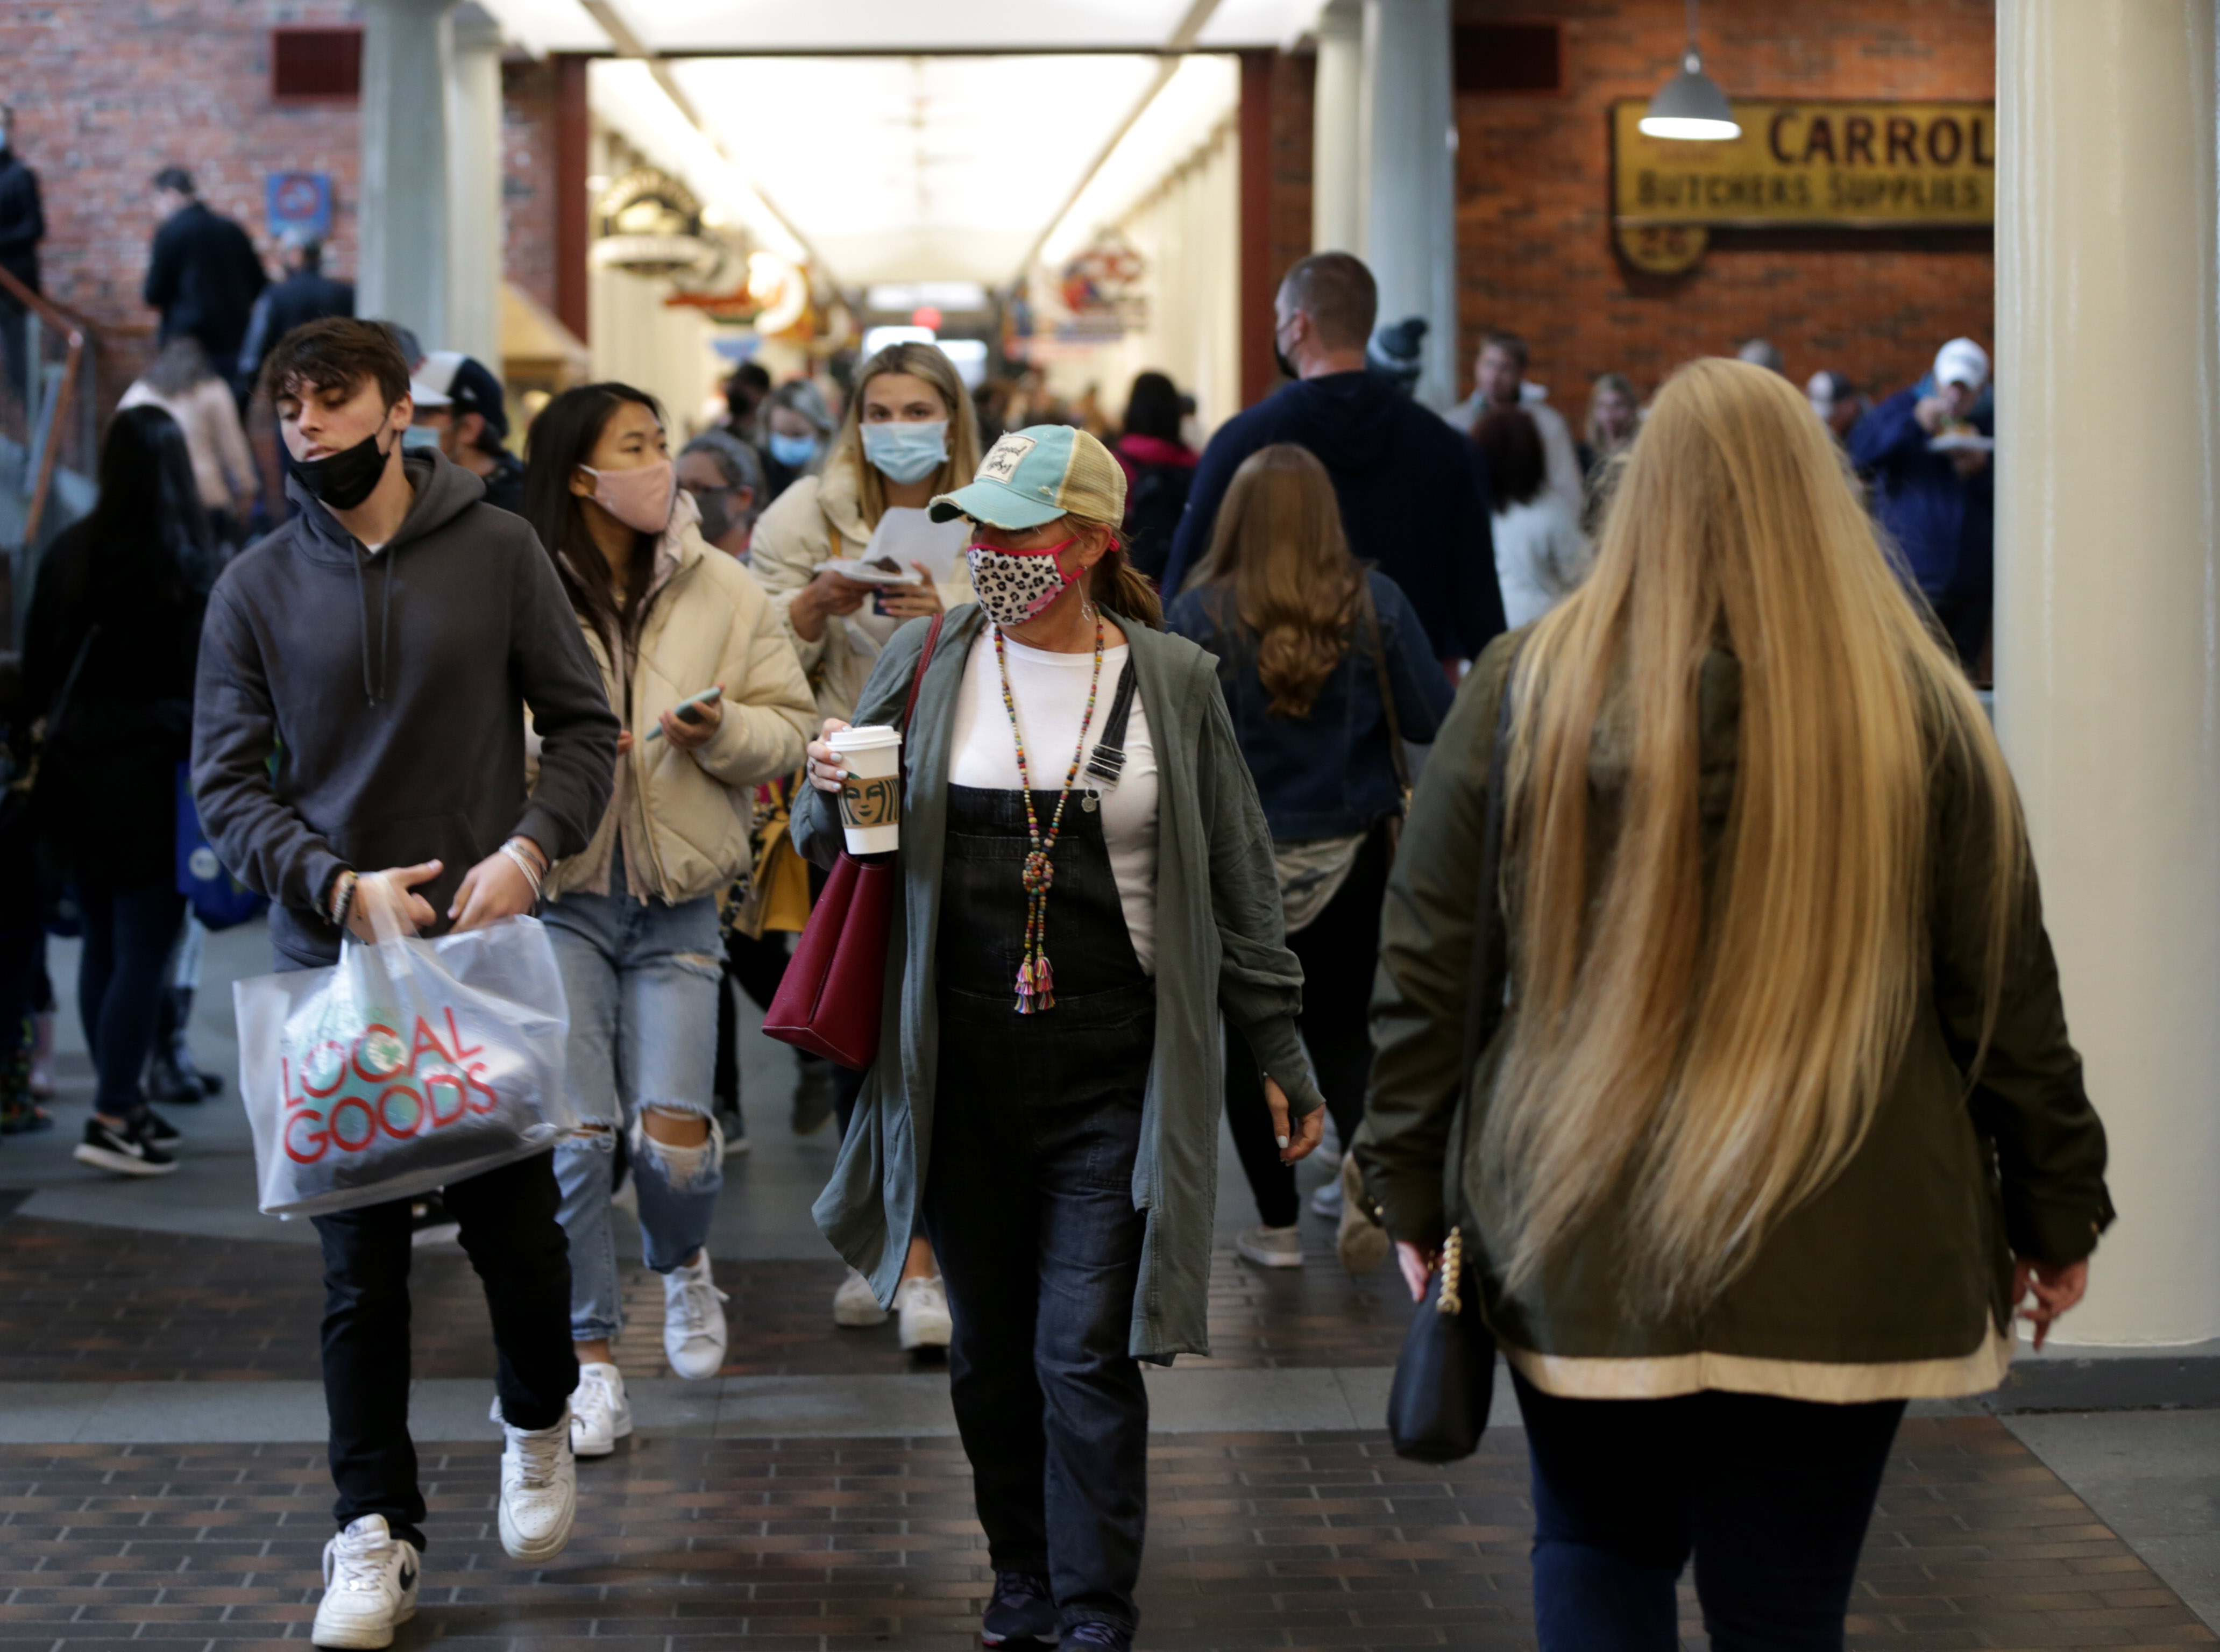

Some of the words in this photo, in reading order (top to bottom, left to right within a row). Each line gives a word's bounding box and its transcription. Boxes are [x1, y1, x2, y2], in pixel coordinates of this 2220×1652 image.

[1767, 111, 1995, 168] CARROL
[1637, 170, 1811, 208] BUTCHERS
[1829, 171, 1981, 209] SUPPLIES
[281, 1006, 485, 1109] LOCAL
[283, 1061, 498, 1164] GOODS
